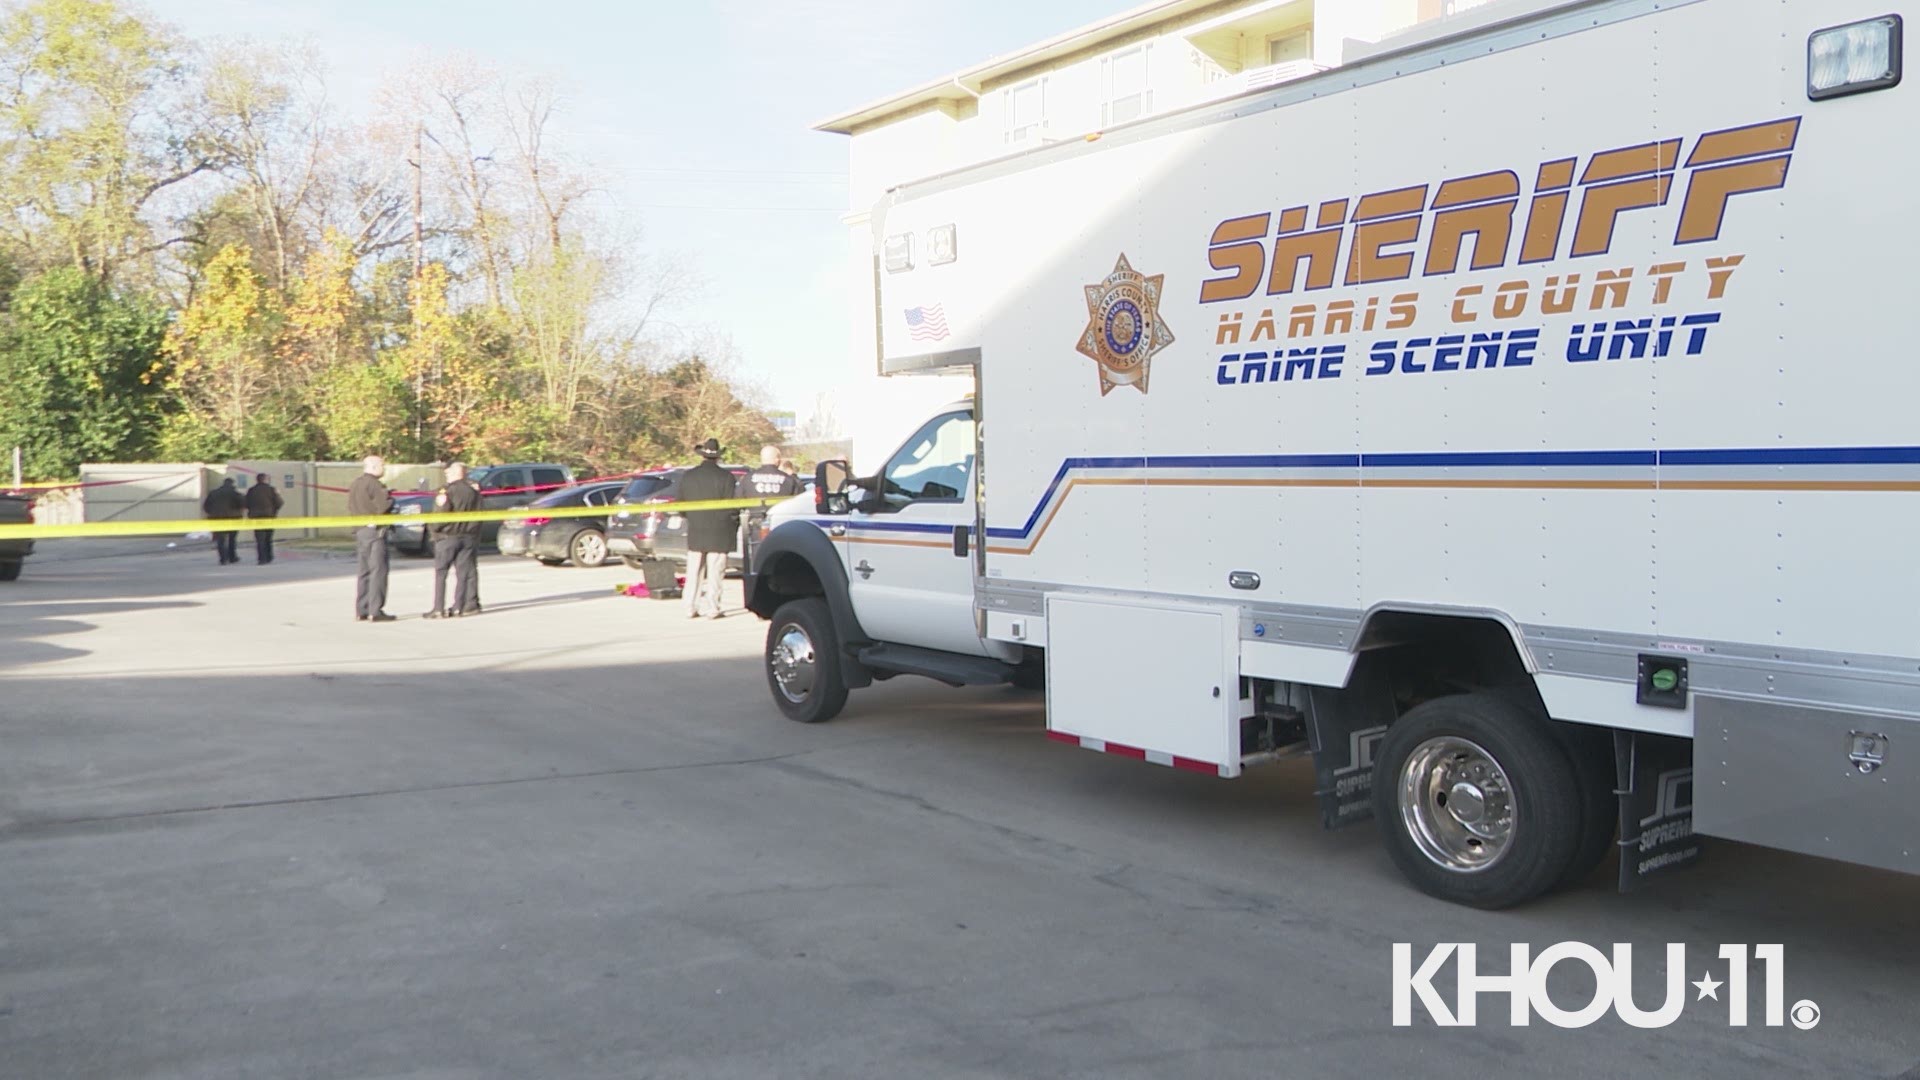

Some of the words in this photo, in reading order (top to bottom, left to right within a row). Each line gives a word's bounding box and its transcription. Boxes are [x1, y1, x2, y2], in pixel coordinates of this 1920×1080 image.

[1199, 115, 1802, 304] SHERIFF
[1099, 289, 1121, 321] HARRIS
[1121, 287, 1150, 314] COUNTY
[1108, 272, 1138, 286] SHERIFF
[1215, 292, 1419, 345] HARRIS
[1451, 254, 1746, 323] COUNTY
[1098, 338, 1129, 367] SHERIFF'S
[1129, 334, 1150, 364] OFFICE
[1216, 344, 1346, 386] CRIME
[1365, 328, 1541, 377] SCENE
[1566, 312, 1722, 363] UNIT
